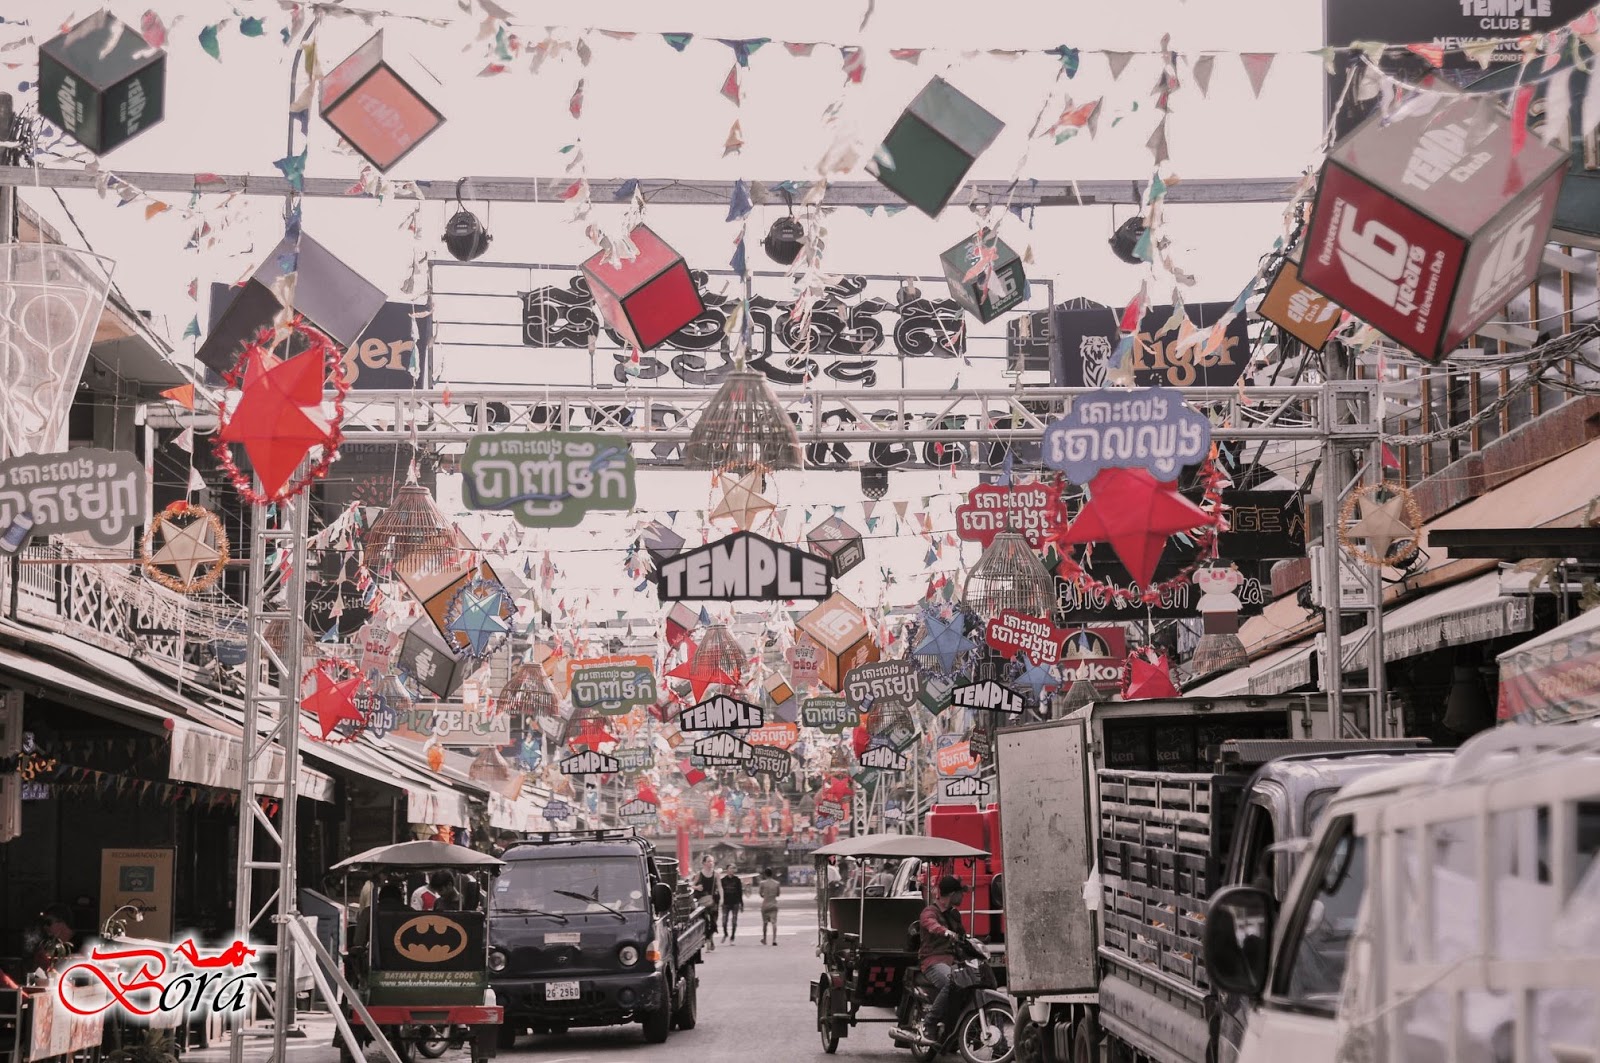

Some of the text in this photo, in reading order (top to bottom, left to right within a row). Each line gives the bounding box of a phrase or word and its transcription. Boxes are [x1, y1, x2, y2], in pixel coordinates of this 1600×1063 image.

[1480, 18, 1530, 30] CLUB 2
[661, 536, 828, 598] TEMPLE
[953, 680, 1023, 712] TEMPLE
[682, 696, 762, 729] TEMPLE
[695, 733, 752, 759] TEMPLE
[861, 746, 907, 769] TEMPLE
[561, 751, 619, 773] TEMPLE
[947, 777, 989, 795] TEMPLE
